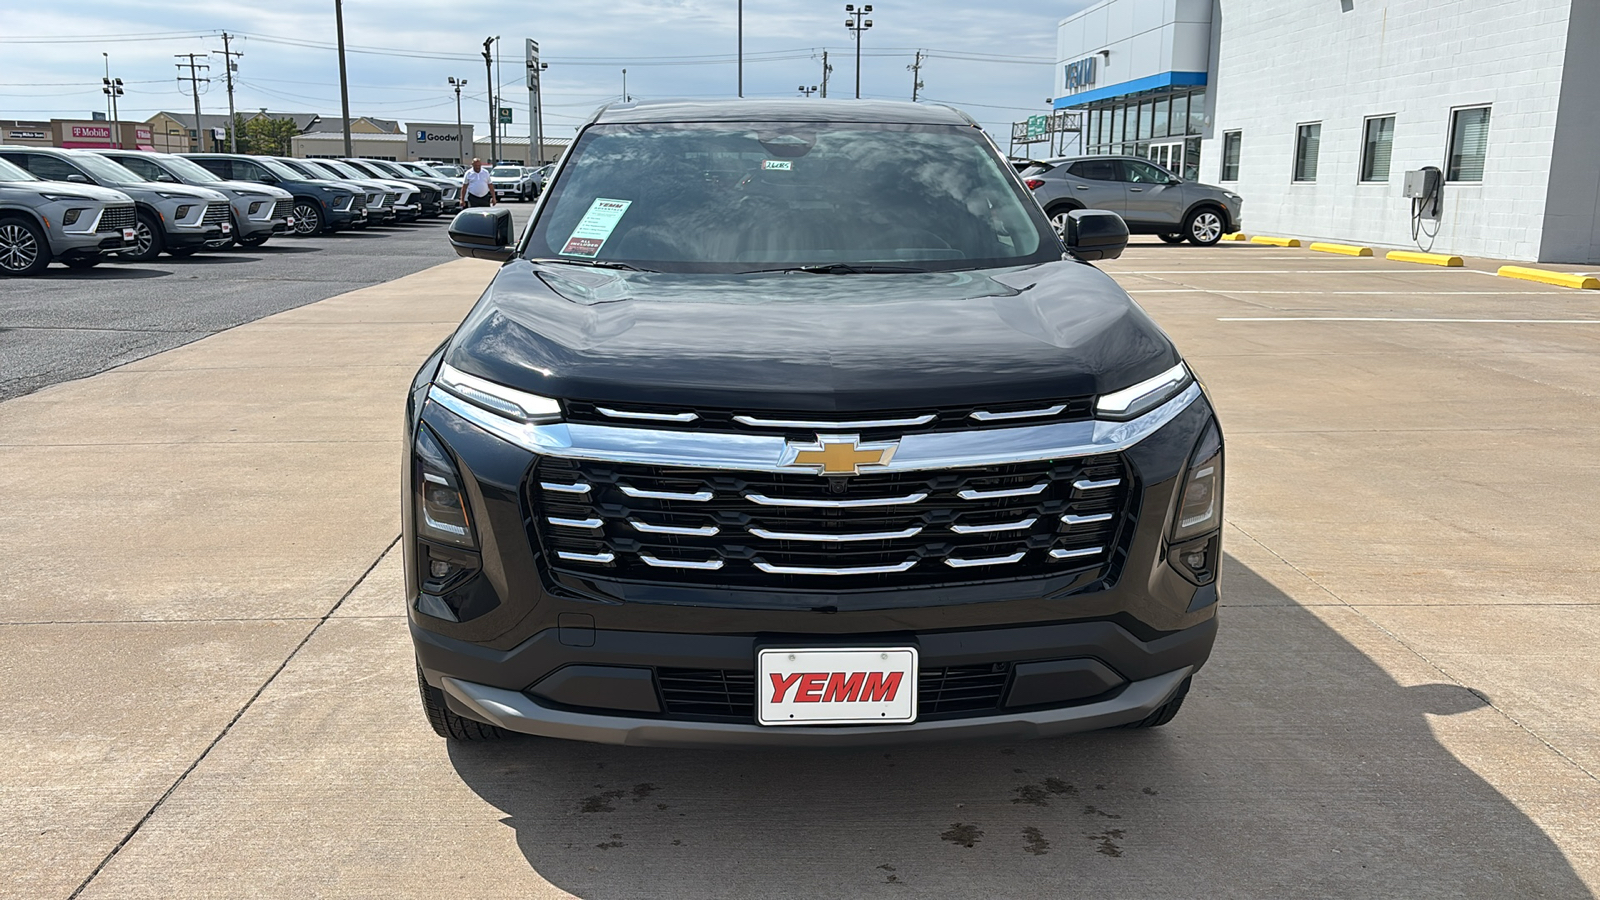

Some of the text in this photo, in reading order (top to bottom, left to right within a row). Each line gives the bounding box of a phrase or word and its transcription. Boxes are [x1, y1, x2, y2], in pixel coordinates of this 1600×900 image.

[1065, 57, 1096, 89] YEMM
[427, 133, 463, 142] Goodwil
[769, 671, 904, 704] YEMM
